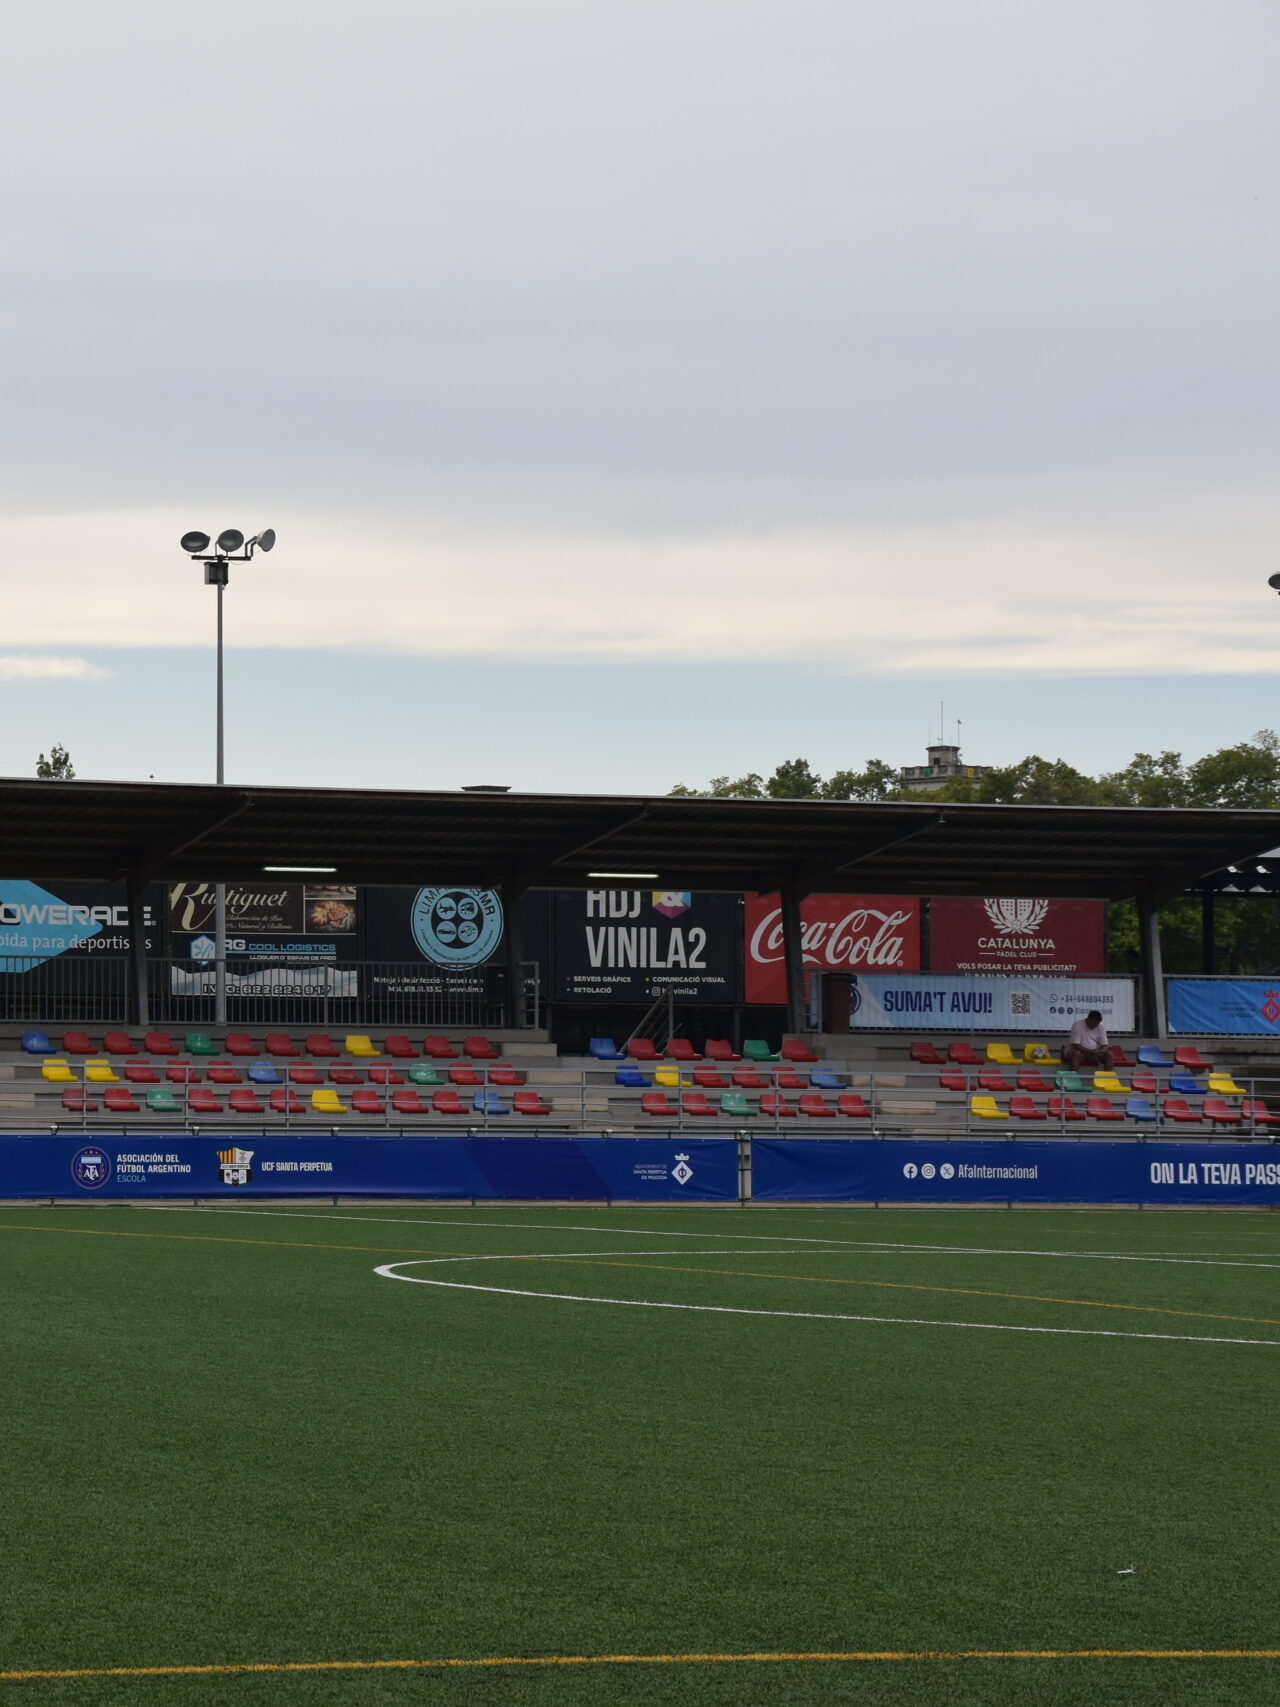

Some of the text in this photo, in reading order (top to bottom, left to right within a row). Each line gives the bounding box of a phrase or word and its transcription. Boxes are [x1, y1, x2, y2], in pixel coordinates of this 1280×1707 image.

[169, 883, 289, 930] Rutiguet
[750, 908, 913, 965] Coa-Cola
[33, 937, 65, 952] para
[69, 934, 152, 953] deportiss
[585, 926, 707, 968] VINILA2
[977, 937, 1055, 950] CATALUNYA
[652, 975, 700, 983] COMUNICACIÓ
[203, 983, 240, 995] INO:
[573, 985, 612, 993] RETOLACIÓ
[883, 991, 993, 1013] SUMA'T AVUI!
[117, 1152, 180, 1163] ASOCIACIÓN DEL
[117, 1163, 192, 1173] FÚTBOL ARGENTINO
[261, 1161, 275, 1171] UCF
[276, 1162, 298, 1171] SANTA
[299, 1162, 333, 1172] PERPETUA
[958, 1164, 1038, 1179] AfaInternacional
[117, 1174, 146, 1183] ESCOLA
[1150, 1162, 1174, 1184] ON
[1179, 1163, 1198, 1184] LA
[1201, 1163, 1242, 1185] TEVA
